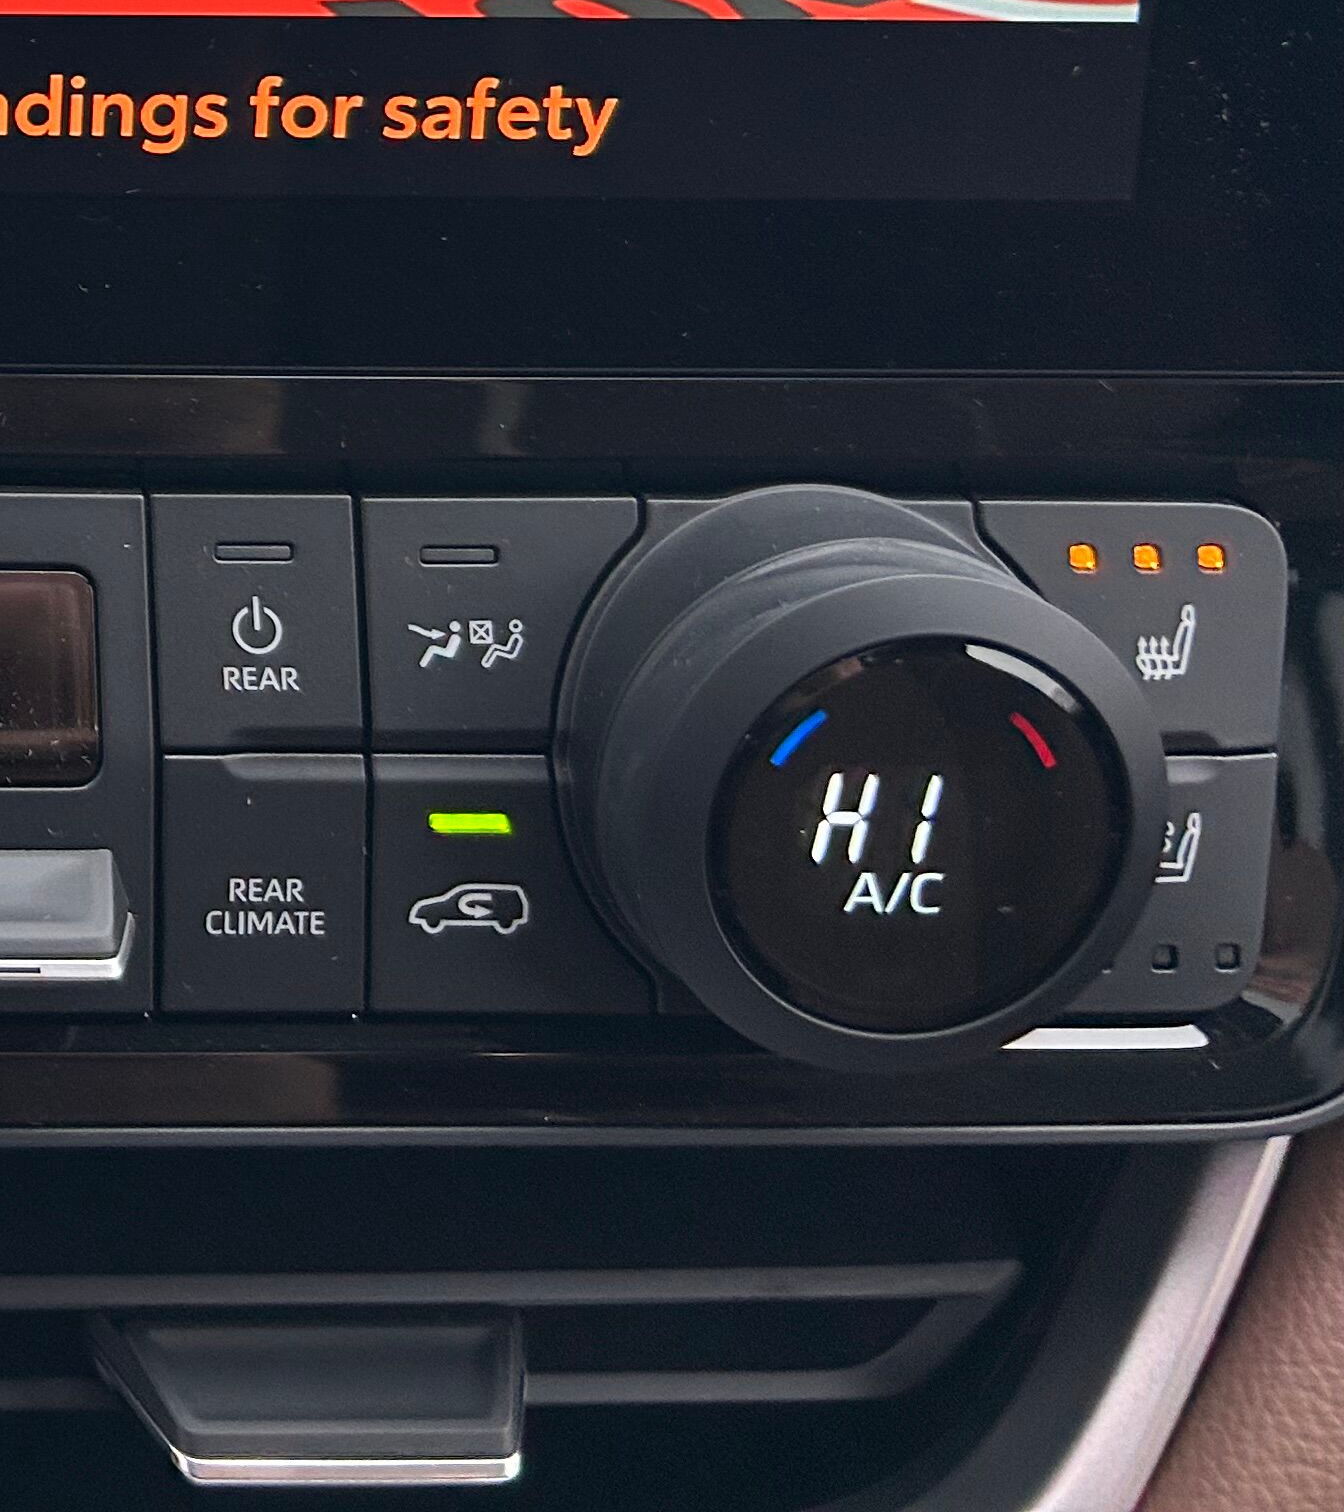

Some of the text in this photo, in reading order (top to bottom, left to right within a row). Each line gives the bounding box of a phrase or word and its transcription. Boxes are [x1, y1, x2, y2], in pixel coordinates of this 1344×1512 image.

[249, 74, 364, 139] for
[382, 76, 619, 157] safety
[223, 666, 300, 692] REAR
[810, 772, 944, 865] HI
[229, 878, 305, 903] REAR
[843, 872, 945, 916] A/C
[205, 910, 326, 935] CLIMATE
